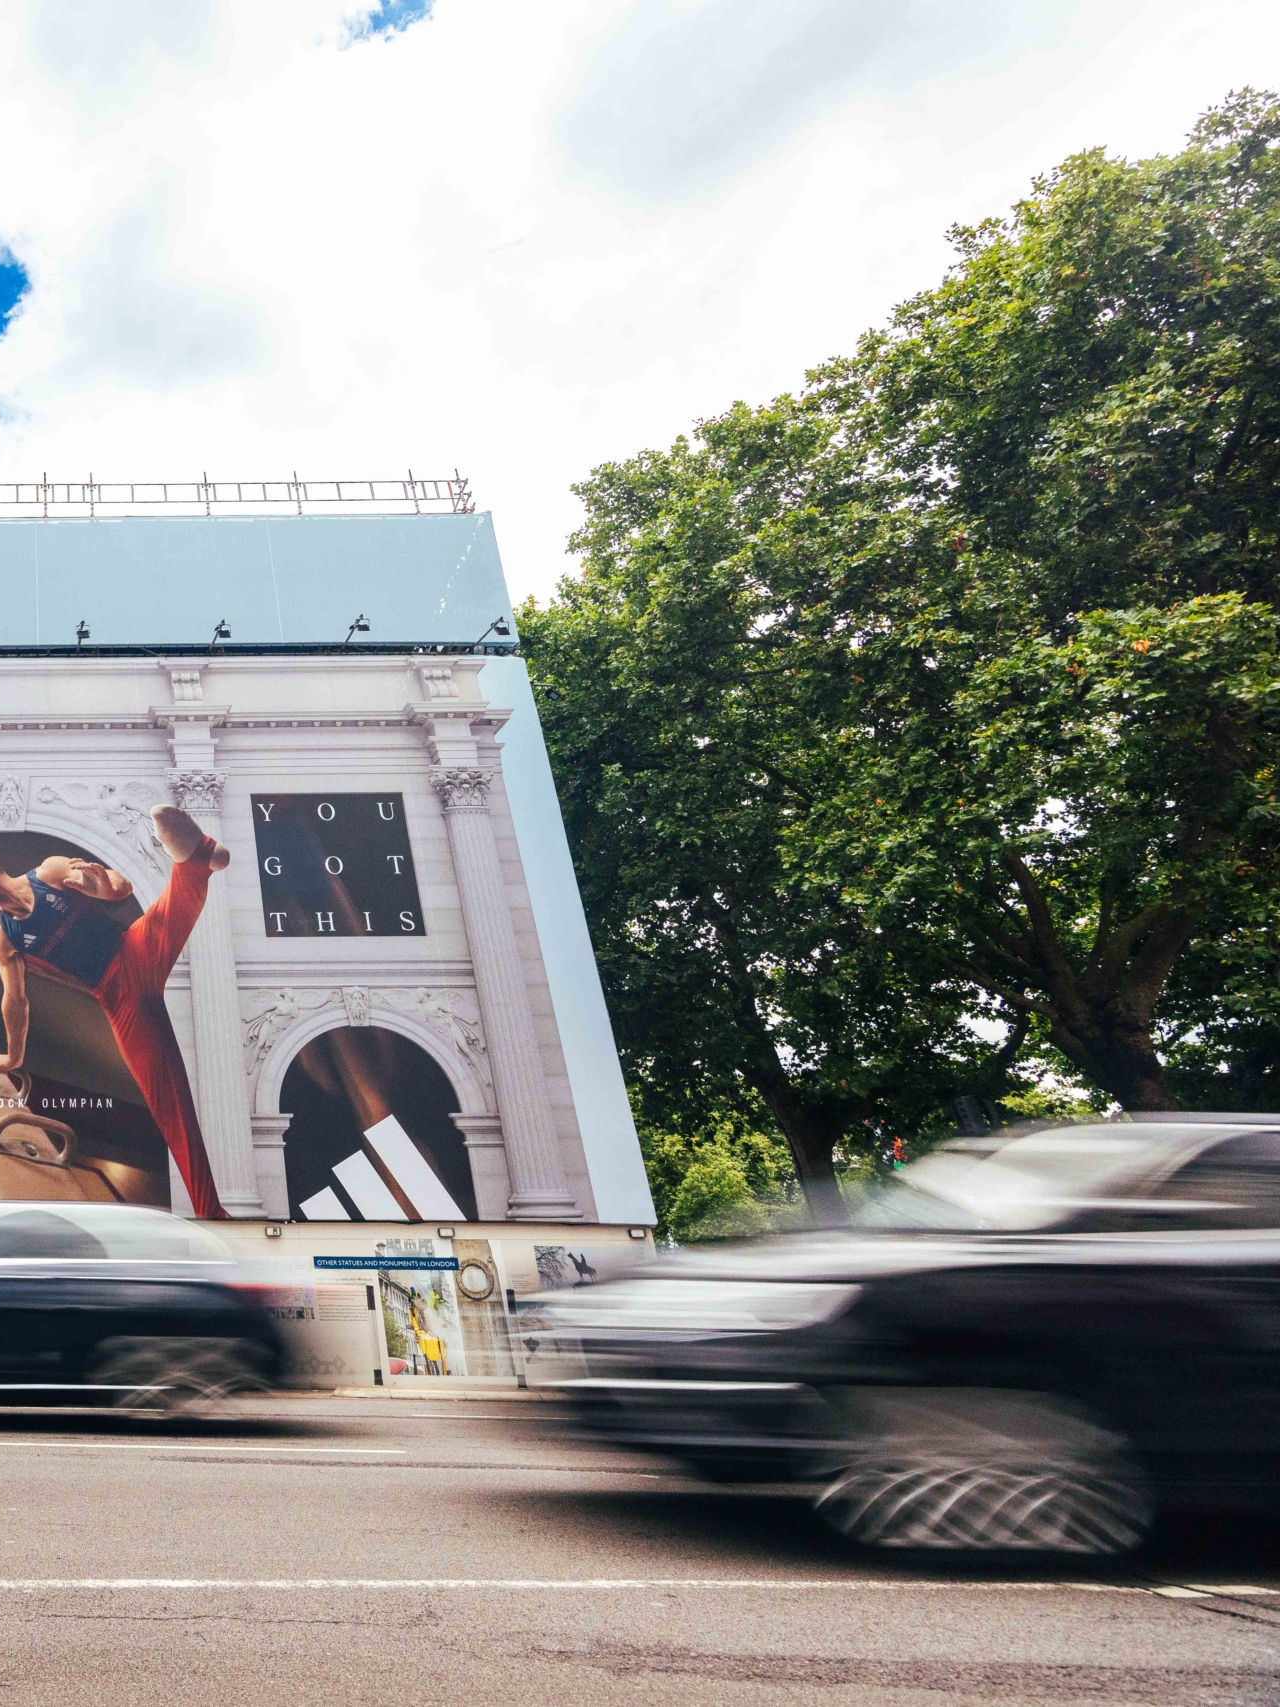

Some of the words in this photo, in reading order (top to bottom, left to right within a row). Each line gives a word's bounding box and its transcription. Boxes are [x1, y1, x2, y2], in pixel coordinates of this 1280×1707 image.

[257, 802, 395, 823] YOU
[263, 855, 405, 877] GOT
[269, 911, 416, 932] THIS
[41, 1098, 113, 1109] OLYMPIAN
